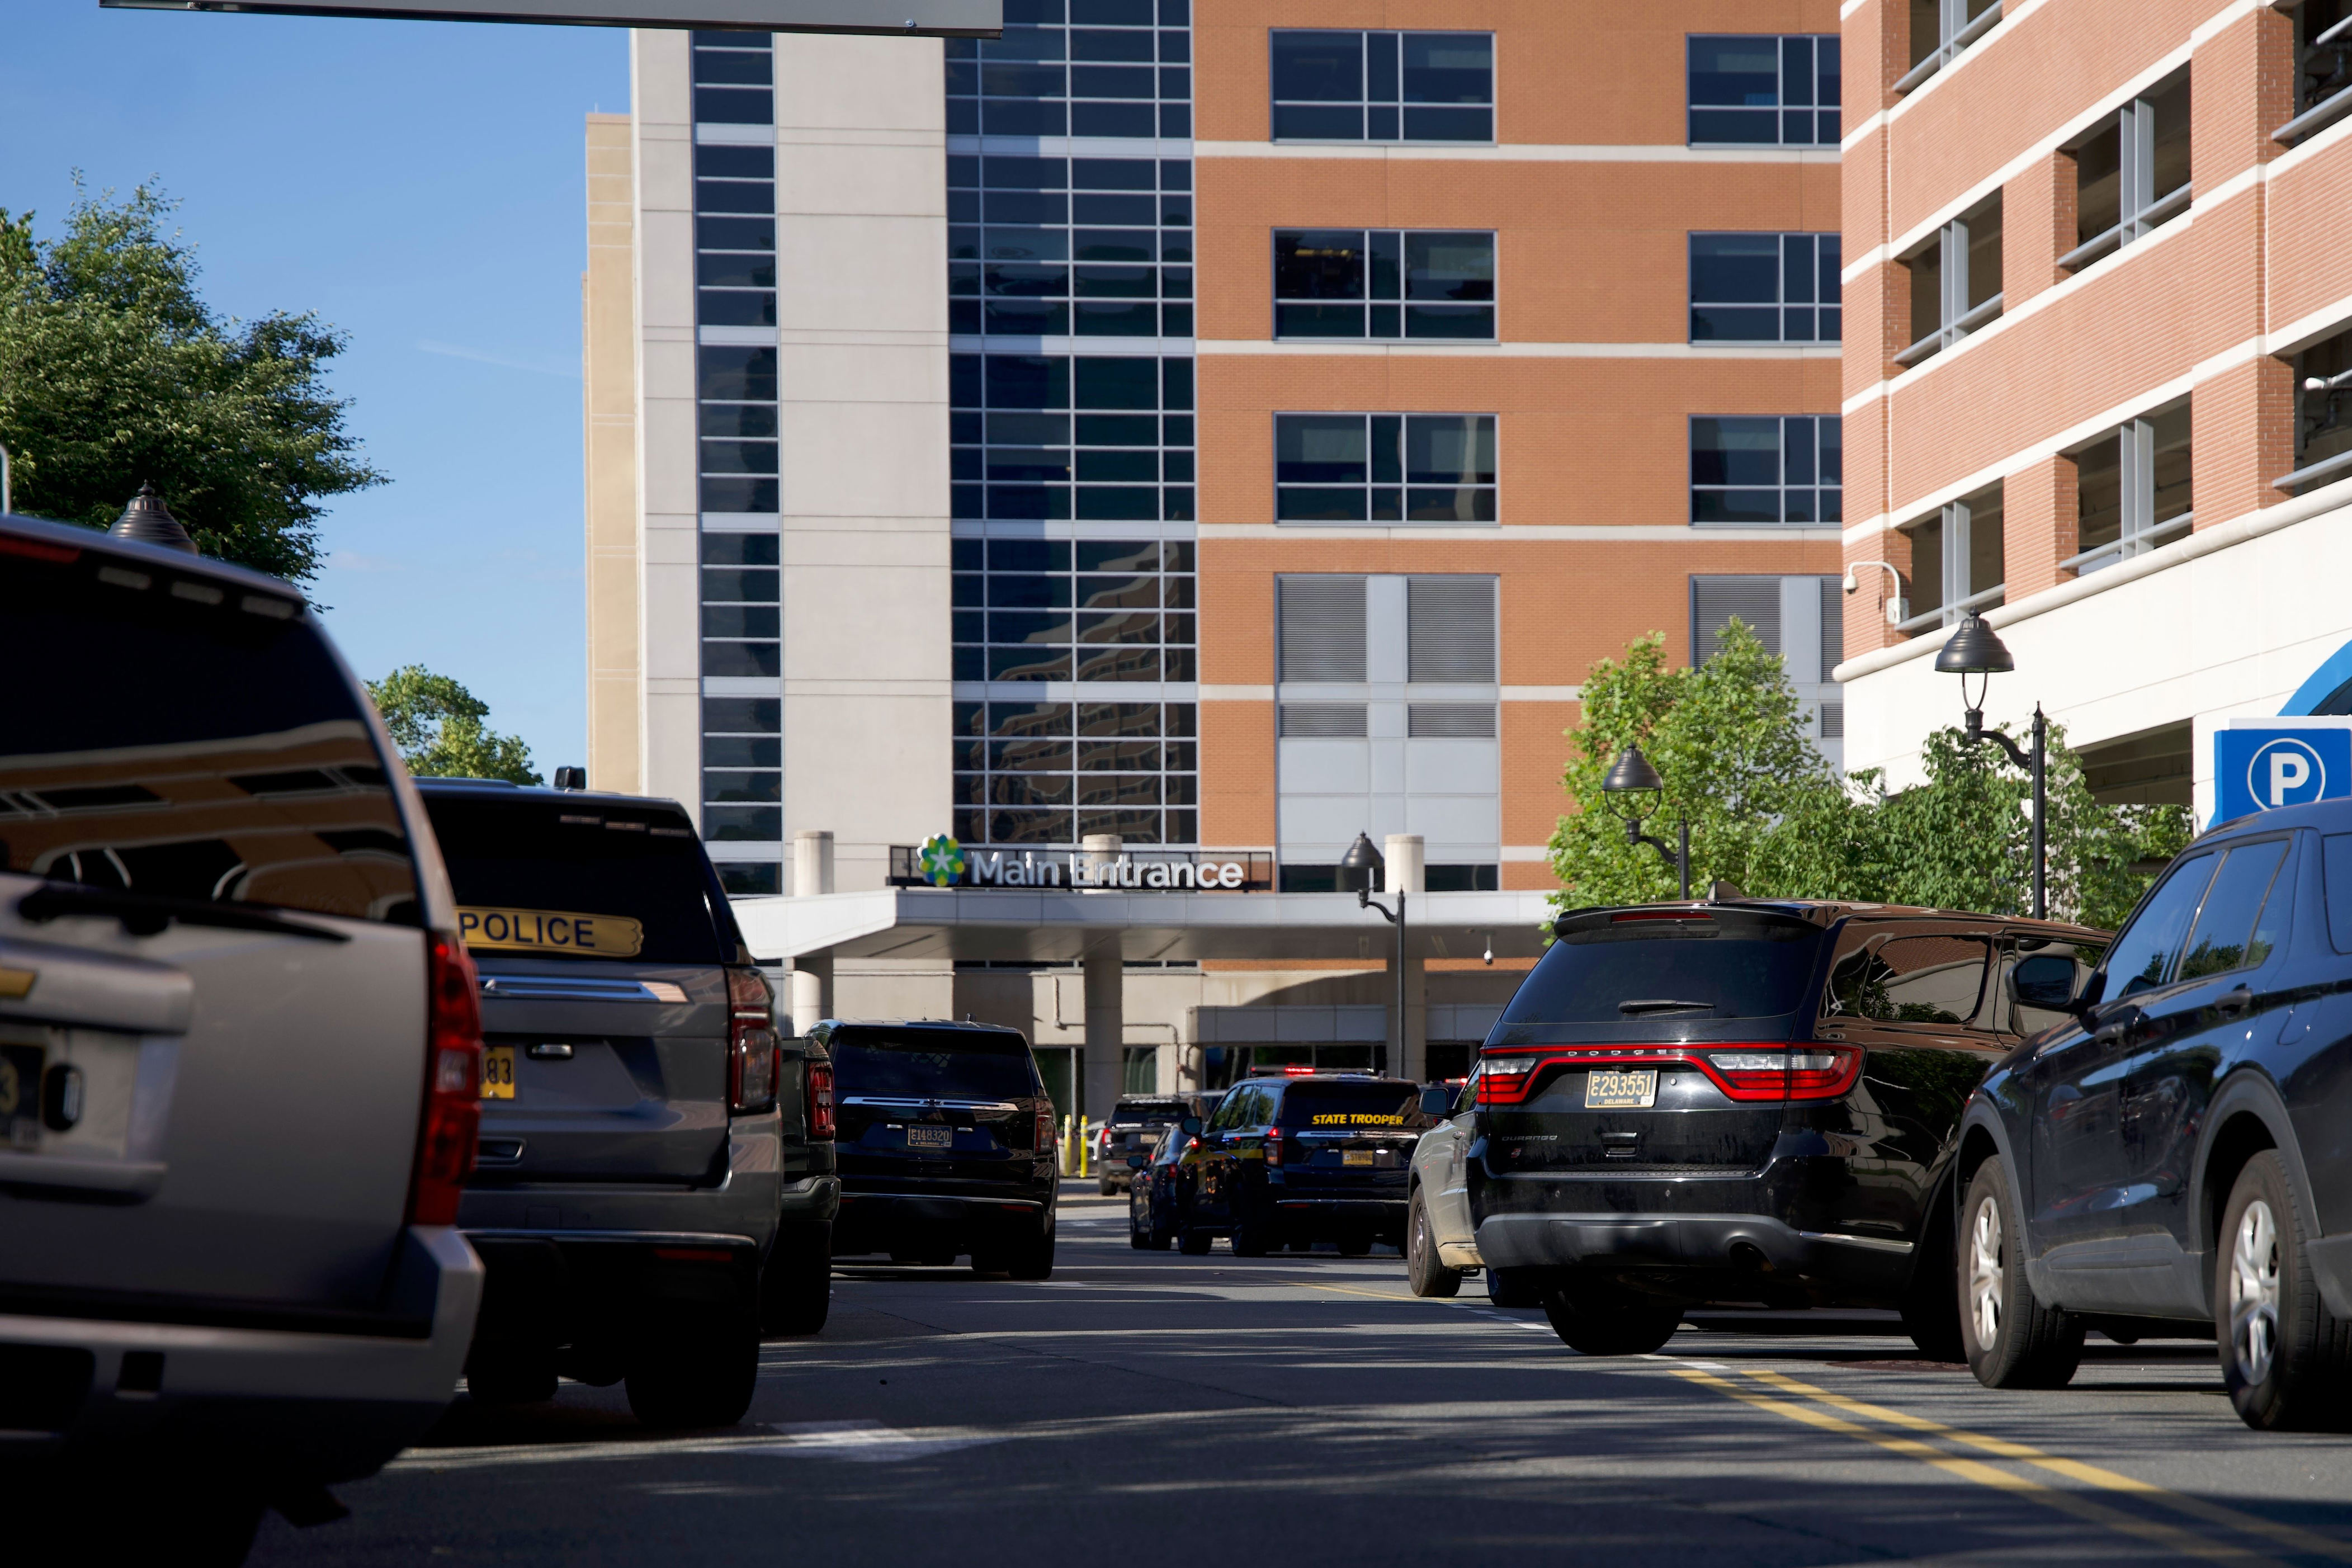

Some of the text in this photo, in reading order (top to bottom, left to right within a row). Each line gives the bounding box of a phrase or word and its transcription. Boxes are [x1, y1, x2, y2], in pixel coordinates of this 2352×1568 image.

[2270, 753, 2310, 806] P
[971, 851, 1244, 888] Main Entrance
[459, 913, 595, 948] POLICE
[1312, 1114, 1404, 1125] STATE TROOPER
